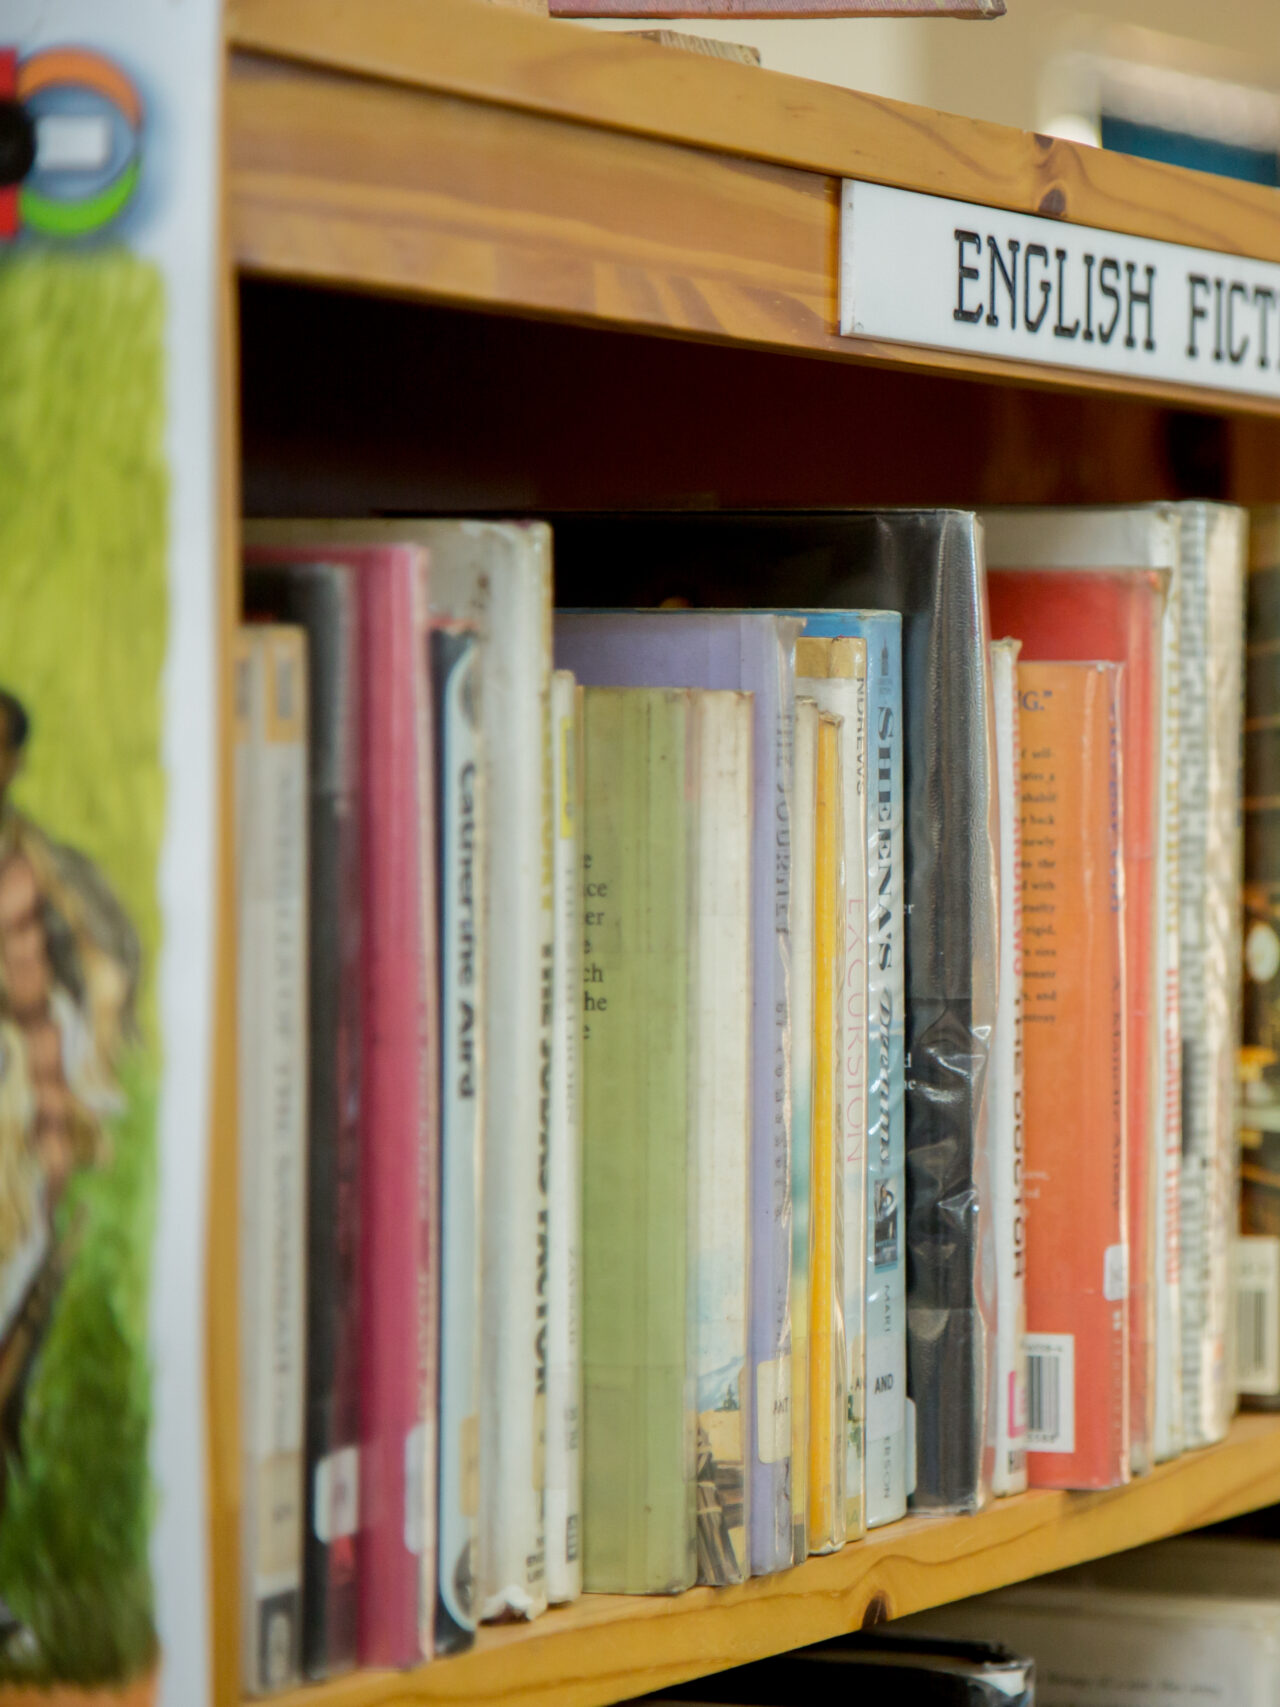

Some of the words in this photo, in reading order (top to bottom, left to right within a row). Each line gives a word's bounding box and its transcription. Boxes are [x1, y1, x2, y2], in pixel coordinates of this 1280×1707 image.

[953, 228, 1156, 352] ENGLISH
[877, 706, 895, 972] SHEENA'S
[457, 1000, 477, 1101] Aird
[846, 897, 865, 1163] EXCURSION
[879, 989, 894, 1165] Dreams
[773, 1397, 790, 1415] ANT
[874, 1373, 894, 1394] AND
